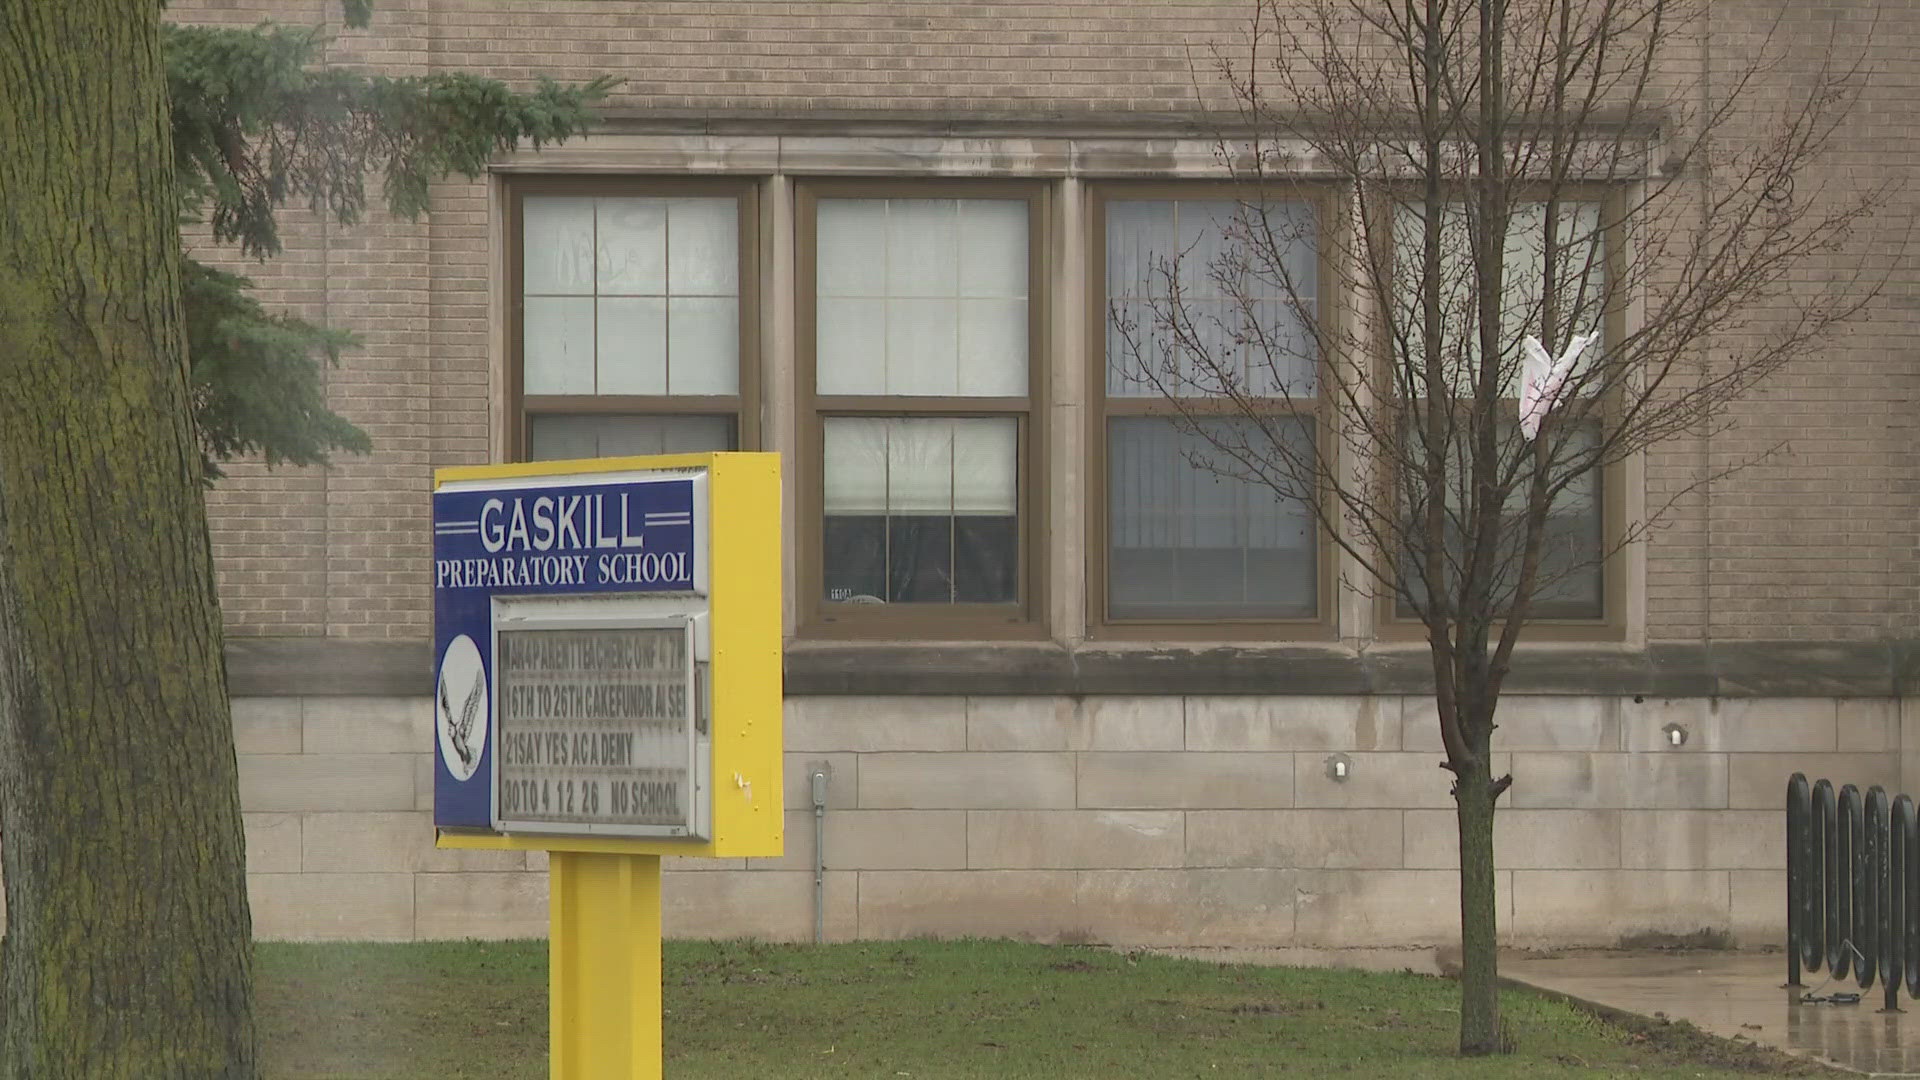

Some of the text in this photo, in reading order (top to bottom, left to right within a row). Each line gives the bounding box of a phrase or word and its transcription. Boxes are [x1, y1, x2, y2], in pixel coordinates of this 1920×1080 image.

[480, 492, 644, 553] GASKILL
[435, 551, 691, 589] PREPARATORY SCHOOL
[506, 684, 534, 718] 16TH
[537, 684, 551, 717] TO
[553, 684, 583, 717] 26TH
[616, 683, 685, 717] FUNDRAISE
[544, 732, 568, 765] YES
[571, 732, 633, 766] ACADEMY
[542, 778, 549, 811] 4
[582, 779, 599, 815] 26
[611, 780, 628, 815] NO
[631, 780, 680, 816] SCHOOL
